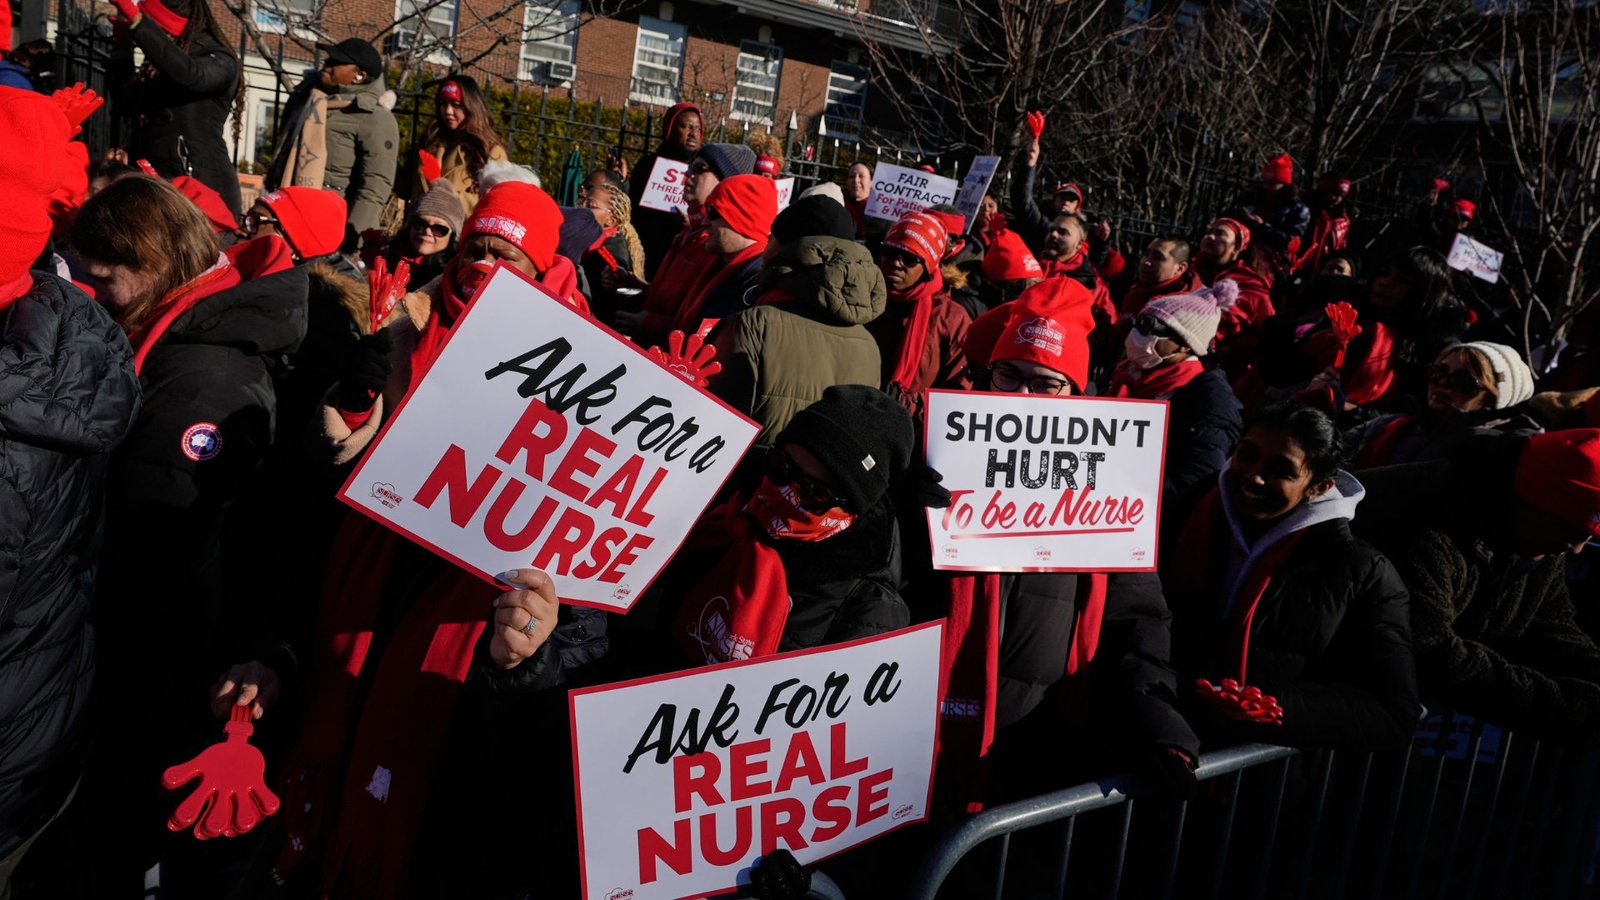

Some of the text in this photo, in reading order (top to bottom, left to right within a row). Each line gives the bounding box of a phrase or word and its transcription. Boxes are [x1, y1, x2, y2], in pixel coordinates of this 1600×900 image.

[875, 181, 950, 206] CONTRACT
[876, 193, 894, 205] For
[897, 172, 929, 189] FAIR
[881, 205, 890, 215] &
[484, 337, 726, 474] Ask For a
[944, 410, 1151, 448] SHOULDN'T
[495, 397, 668, 528] REAL
[985, 448, 1106, 490] HURT
[413, 443, 655, 585] NURSE
[941, 485, 1144, 532] To be a Nurse
[622, 661, 901, 774] Ask For a
[941, 700, 981, 716] URSES
[673, 722, 869, 814] REAL
[637, 767, 894, 886] NURSE
